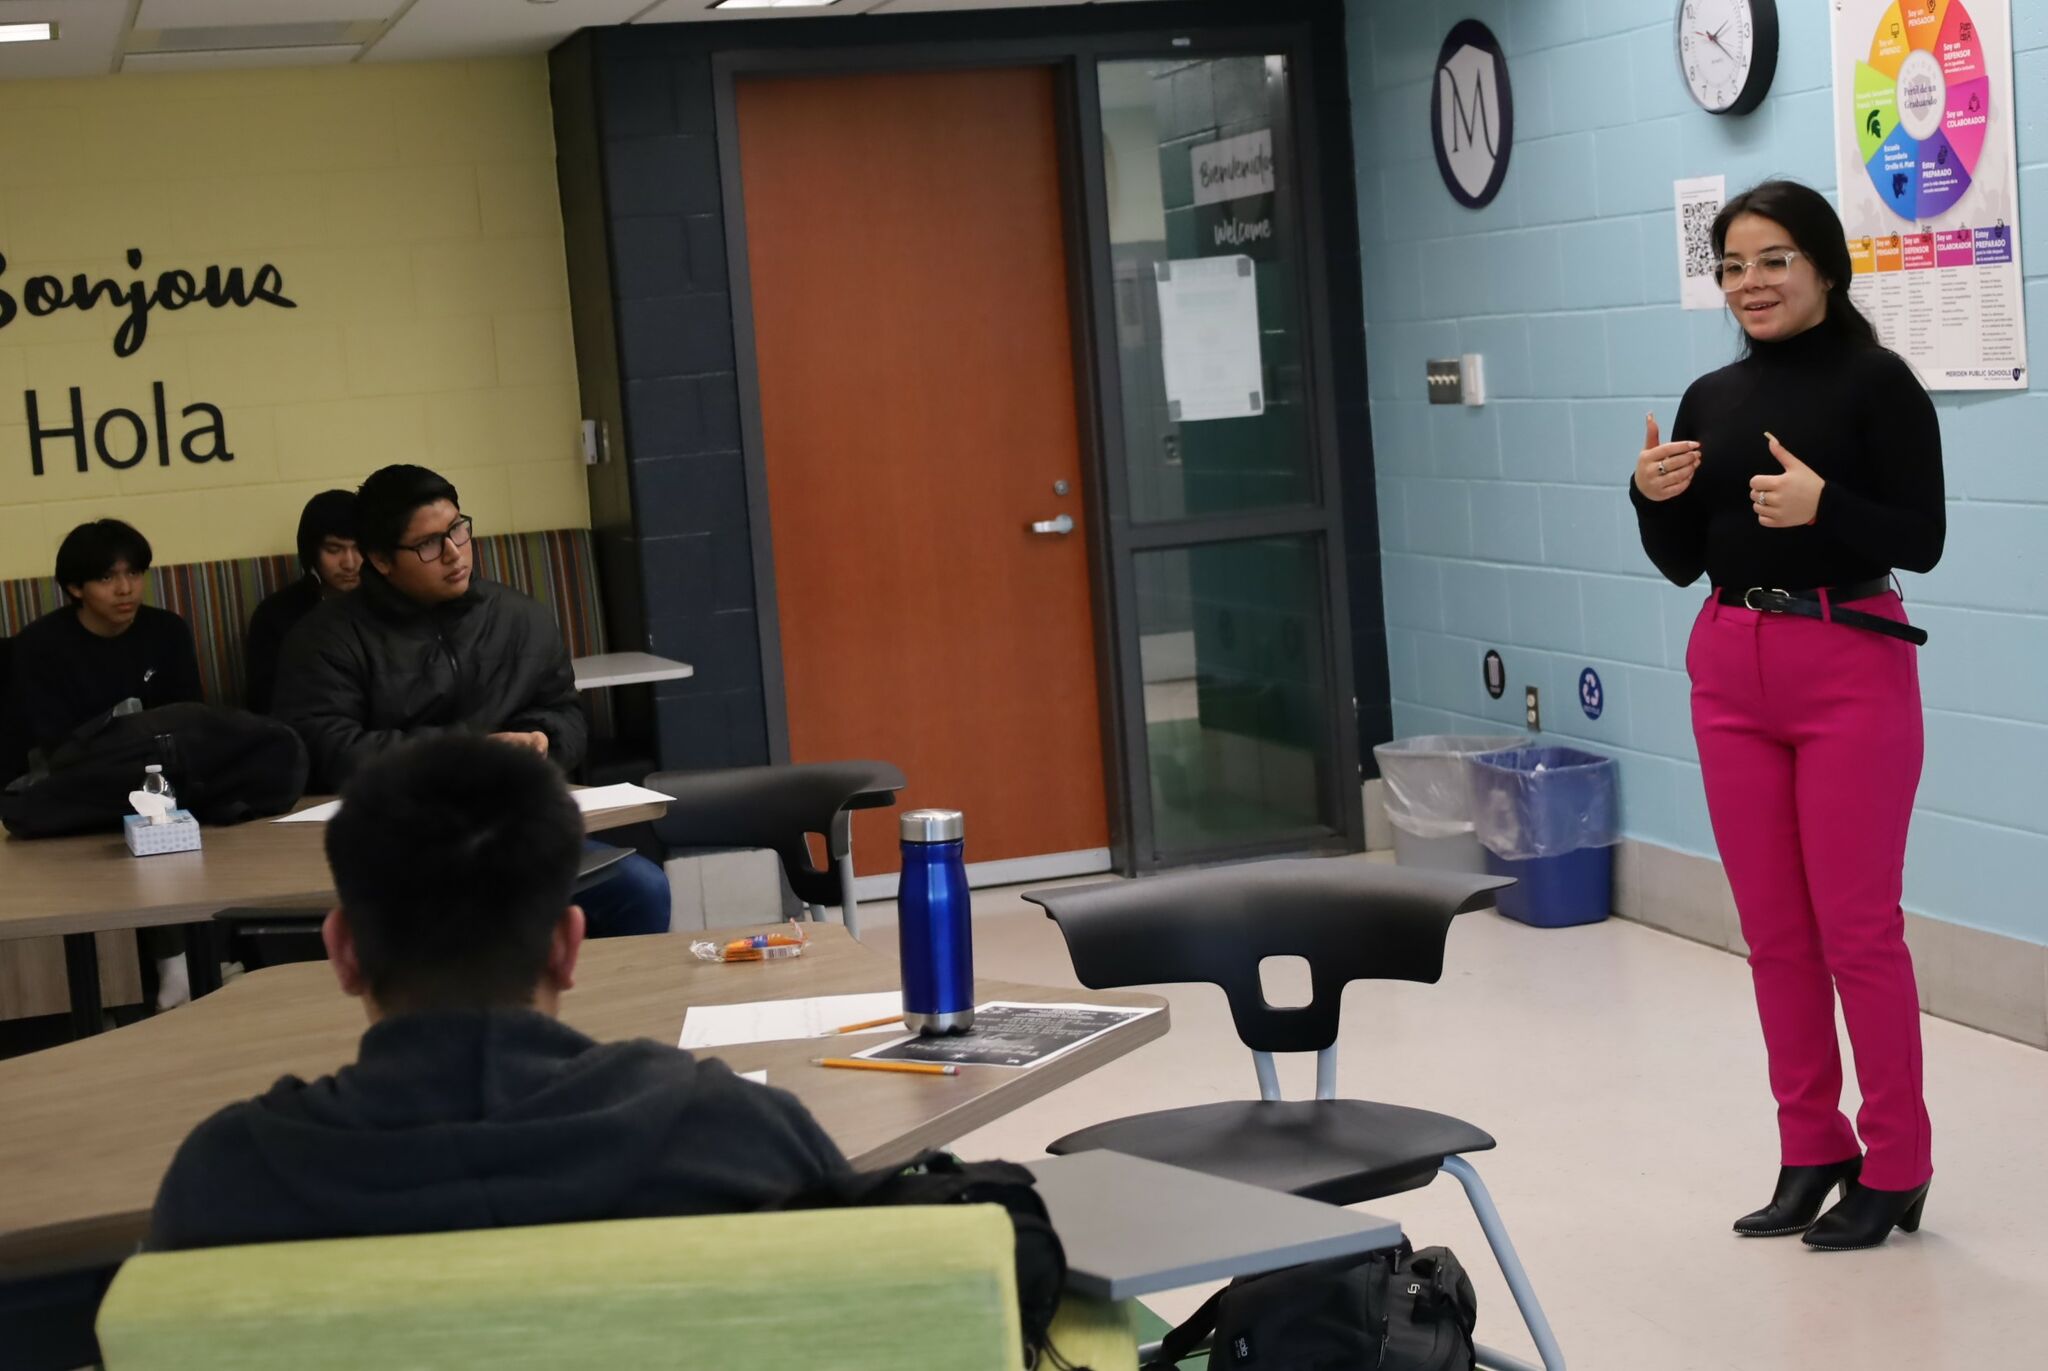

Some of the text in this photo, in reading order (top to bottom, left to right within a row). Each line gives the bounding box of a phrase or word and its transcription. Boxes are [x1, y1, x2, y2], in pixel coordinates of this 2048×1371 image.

[1743, 22, 1750, 39] 3
[1683, 36, 1690, 52] 9
[1943, 43, 1953, 52] Soy
[1943, 49, 1971, 61] DEFENSOR
[1689, 65, 1695, 82] 8
[1701, 84, 1707, 100] 7
[1440, 64, 1497, 160] M
[1946, 110, 1956, 119] Soy
[1946, 115, 1986, 129] COLABORADOR
[1922, 168, 1952, 179] PREPARADO
[1904, 237, 1913, 246] Soy
[1936, 234, 1945, 242] Soy
[1975, 238, 2006, 249] PREPARADO
[1904, 245, 1929, 255] DEFENSOR
[1936, 241, 1972, 251] COLABORADOR
[24, 381, 235, 477] Hola
